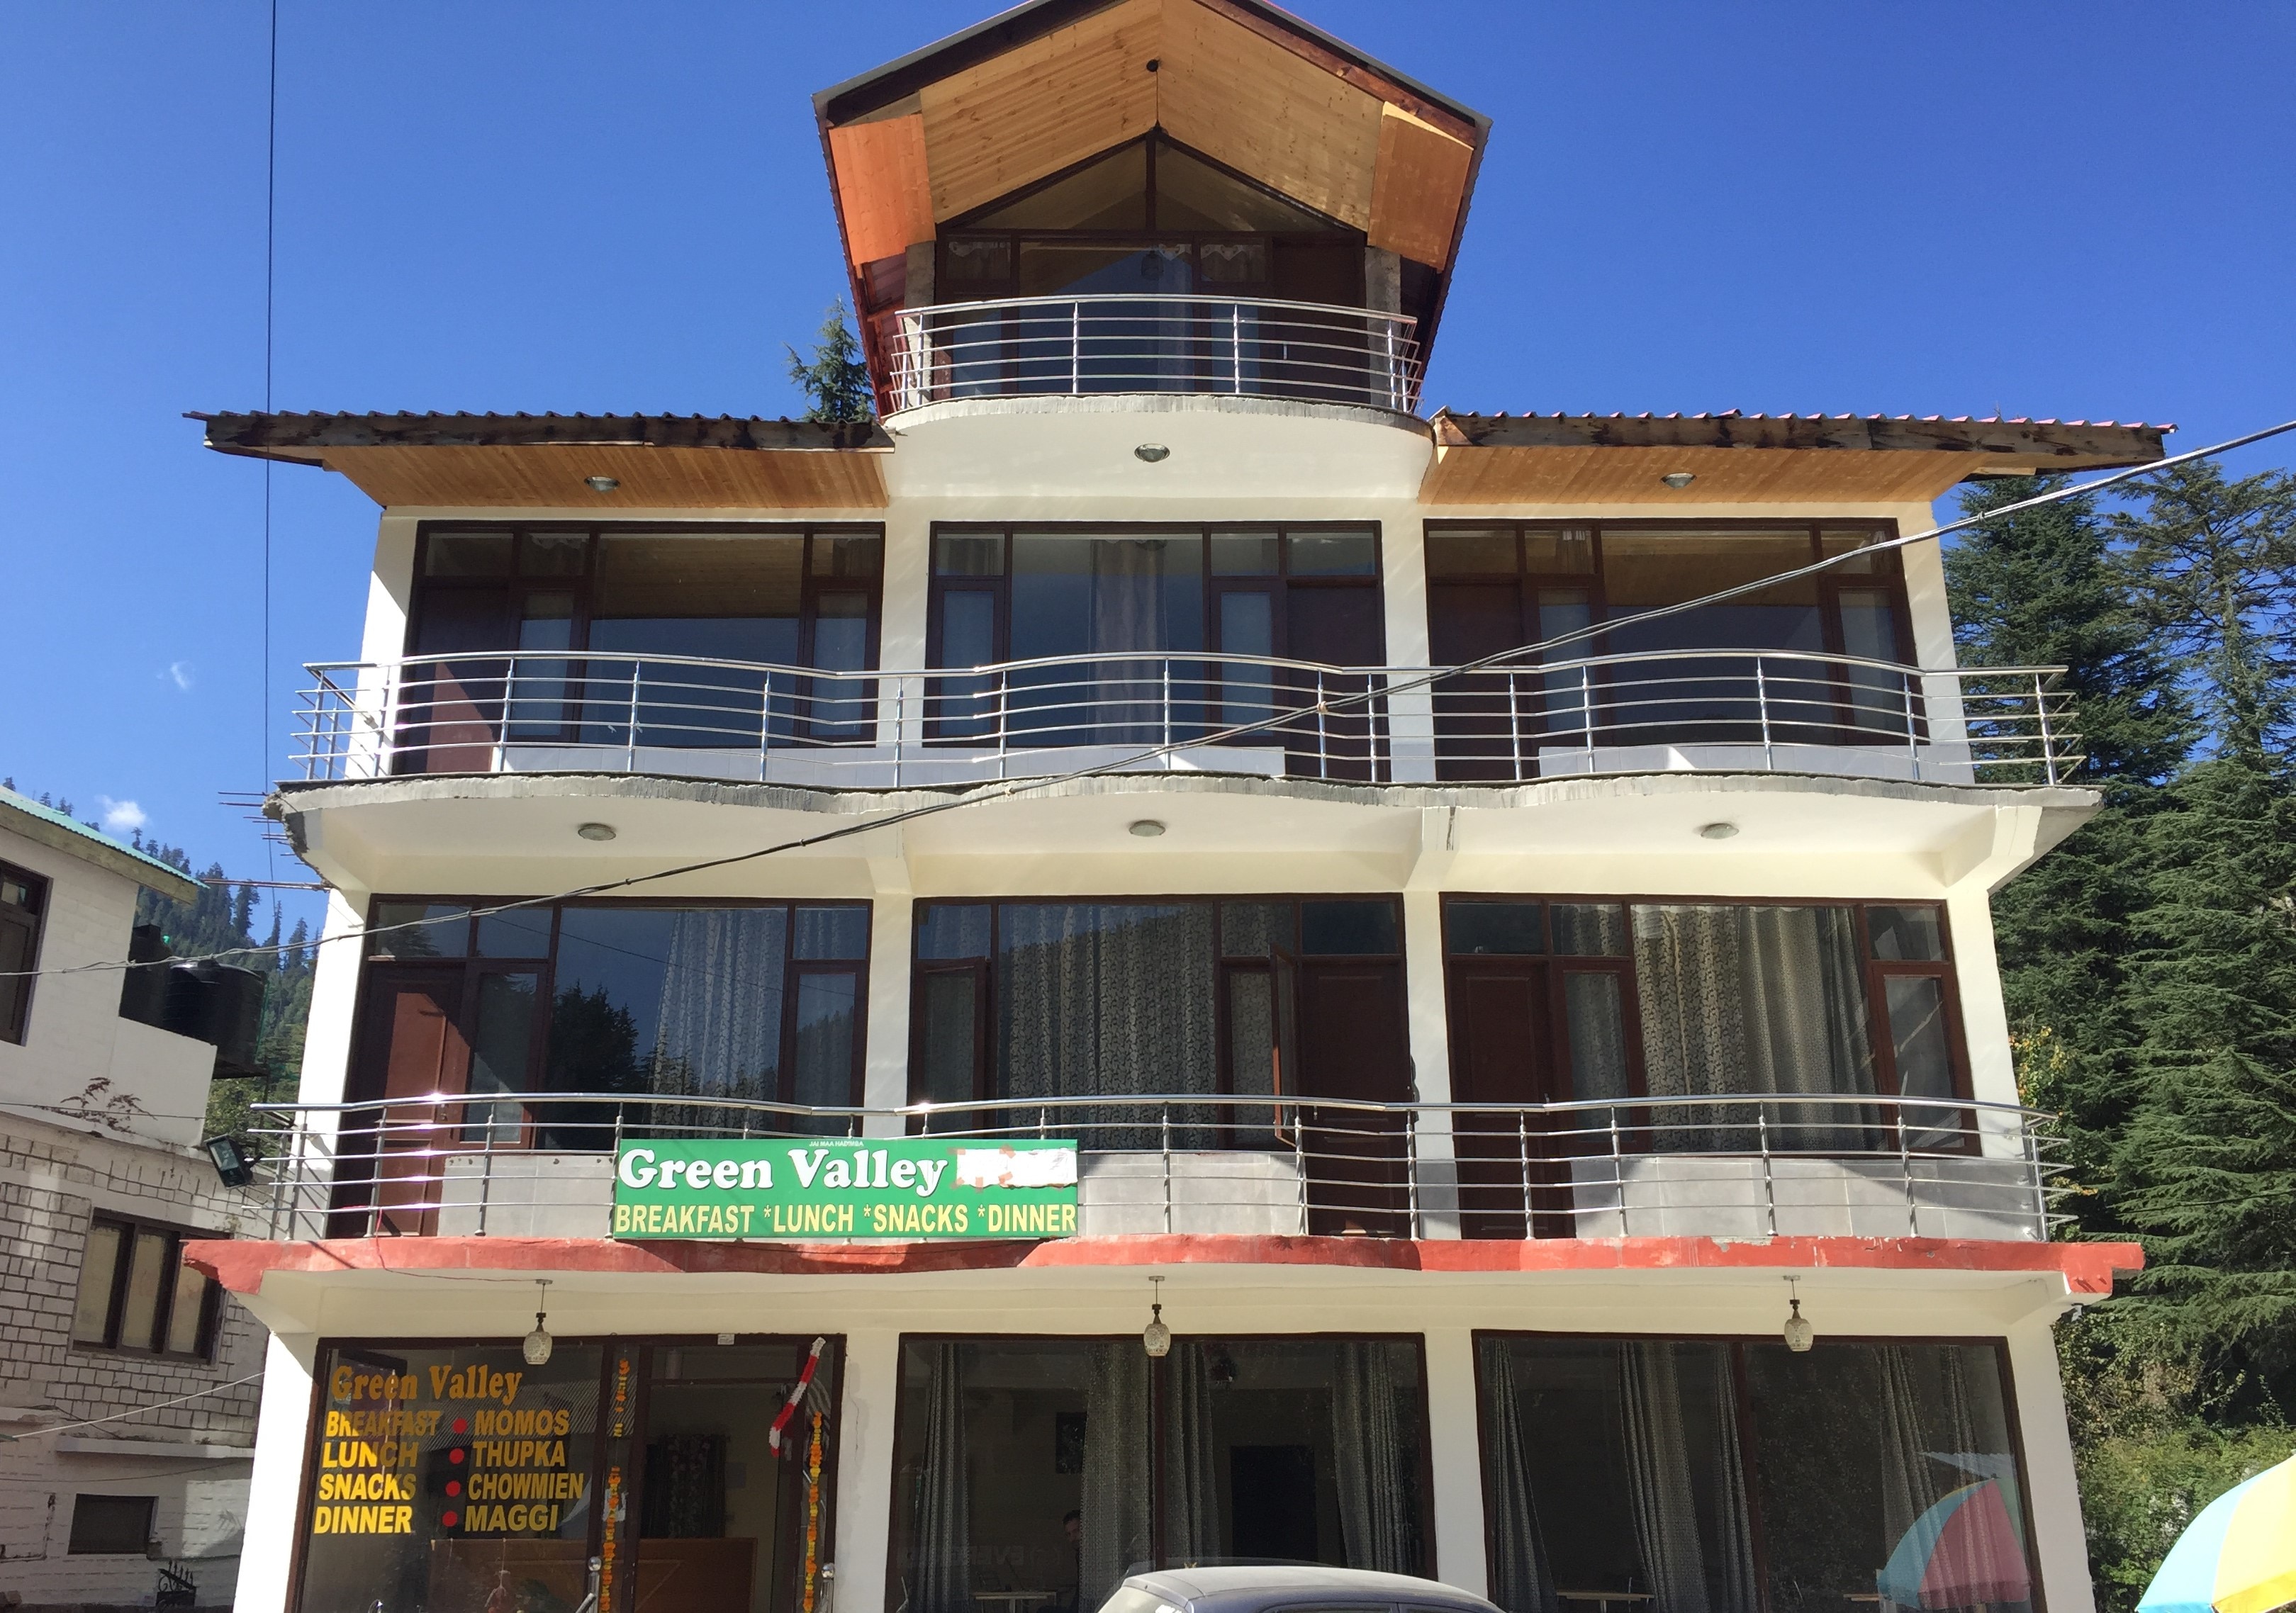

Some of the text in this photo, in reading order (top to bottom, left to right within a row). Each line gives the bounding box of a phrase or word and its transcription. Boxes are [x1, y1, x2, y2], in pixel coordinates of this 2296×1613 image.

[618, 1148, 948, 1197] Green Valley
[615, 1204, 755, 1233] BREAKFAST
[331, 1364, 523, 1405] Green Valley
[325, 1410, 442, 1437] BREAKFAST
[474, 1409, 570, 1437] MOMOS
[322, 1441, 418, 1468] LUNCH
[472, 1441, 566, 1468] THUPKA
[318, 1473, 417, 1501] SNACKS
[467, 1472, 584, 1500] CHOWMIEN
[313, 1505, 413, 1534] DINNER
[464, 1504, 559, 1532] MAGGI
